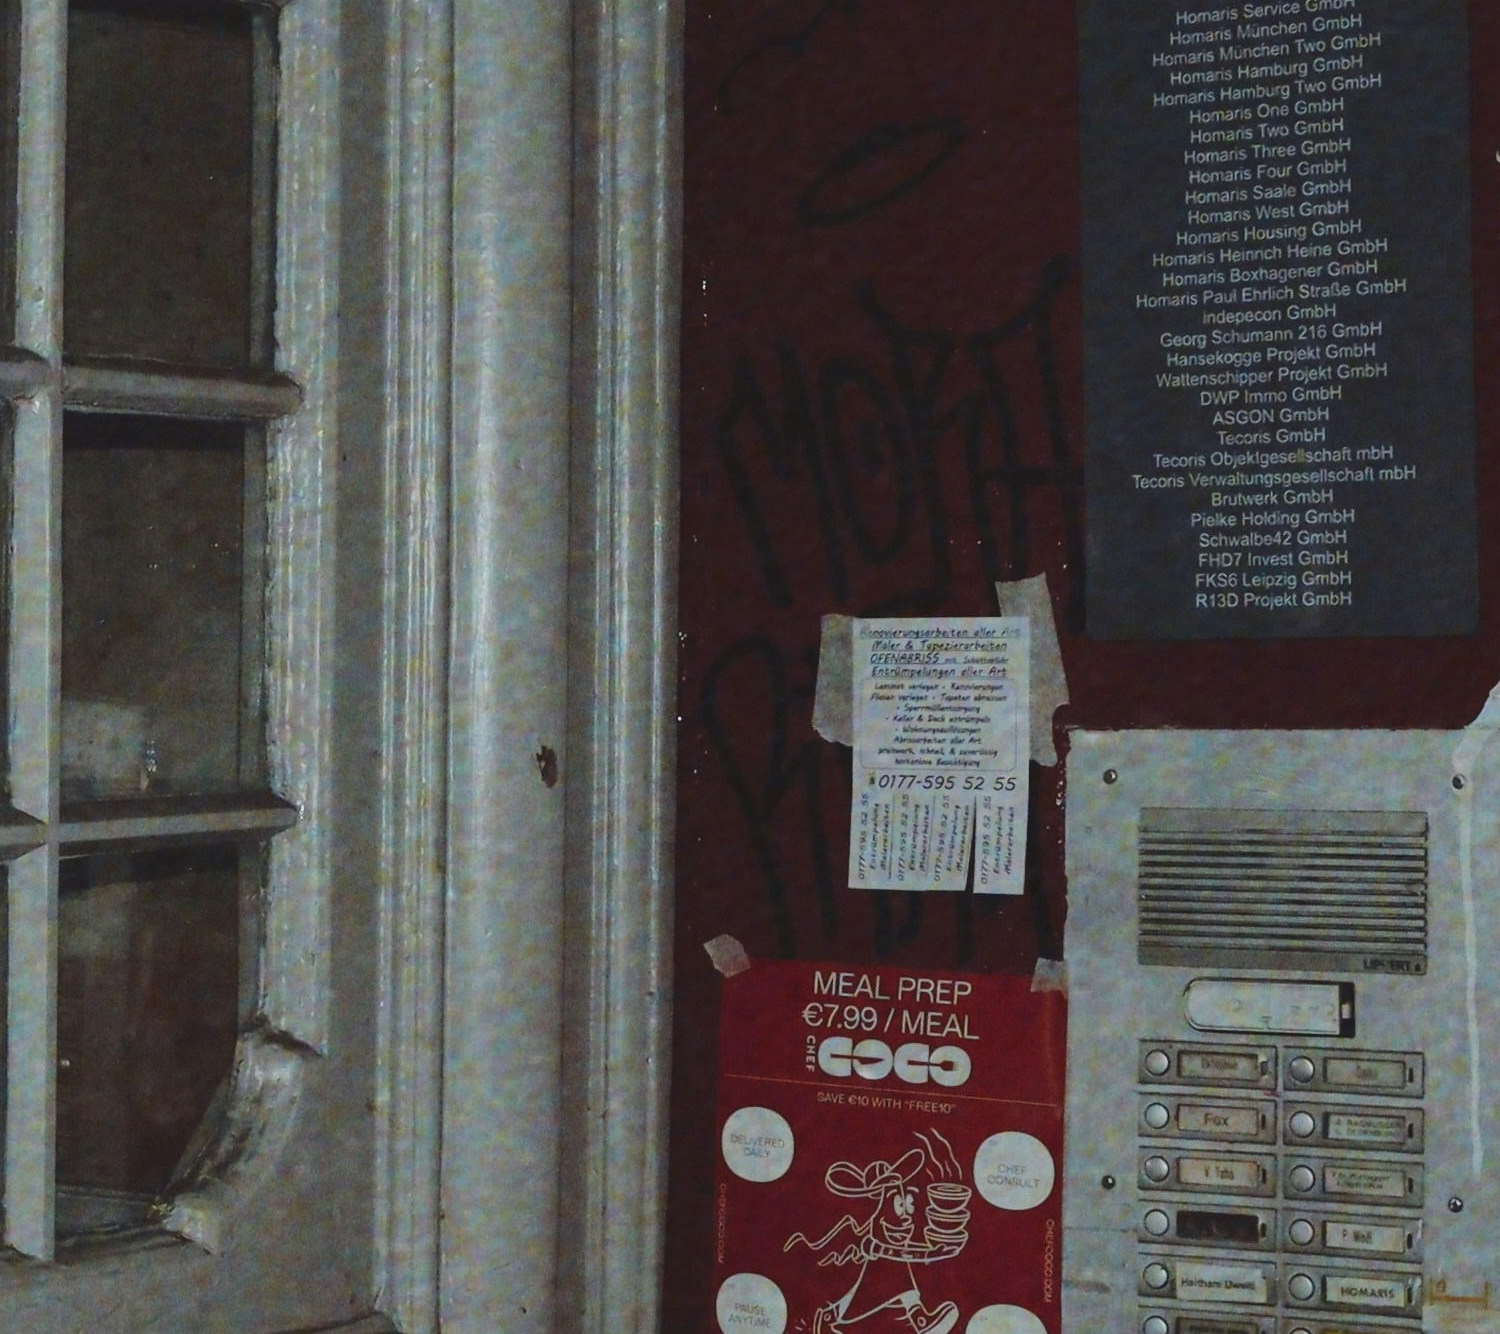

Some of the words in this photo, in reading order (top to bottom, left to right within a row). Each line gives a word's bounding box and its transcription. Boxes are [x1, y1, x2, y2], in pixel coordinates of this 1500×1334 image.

[1176, 6, 1238, 26] Homaris
[1243, 1, 1301, 19] Service
[1170, 27, 1232, 46] Homaris
[1237, 21, 1307, 39] München
[1312, 14, 1362, 32] GmbH
[1152, 48, 1215, 67] Homaris
[1219, 42, 1290, 61] München
[1294, 39, 1326, 54] Two
[1331, 32, 1382, 50] GmbH
[1170, 67, 1232, 86] Homaris
[1237, 62, 1308, 80] Hamburg
[1313, 54, 1363, 73] GmbH
[1153, 88, 1215, 107] Homaris
[1220, 84, 1290, 101] Hamburg
[1295, 80, 1326, 94] Two
[1332, 73, 1382, 91] GmbH
[1189, 106, 1252, 124] Homaris
[1257, 103, 1290, 118] One
[1294, 96, 1344, 115] GmbH
[1190, 126, 1253, 144] Homaris
[1258, 124, 1290, 138] Two
[1294, 117, 1344, 135] GmbH
[1184, 146, 1247, 164] Homaris
[1251, 144, 1296, 159] Three
[1301, 138, 1352, 155] GmbH
[1189, 166, 1252, 184] Homaris
[1257, 164, 1292, 179] Four
[1297, 159, 1347, 176] GmbH
[1185, 187, 1248, 205] Homaris
[1252, 183, 1297, 200] Saale
[1301, 179, 1352, 196] GmbH
[1188, 207, 1251, 225] Homaris
[1255, 203, 1294, 220] West
[1299, 199, 1350, 217] GmbH
[1176, 228, 1239, 246] Homaris
[1244, 224, 1307, 241] Housing
[1311, 219, 1362, 236] GmbH
[1153, 250, 1215, 267] Homaris
[1287, 243, 1332, 259] Heine
[1337, 238, 1388, 255] GmbH
[1163, 269, 1225, 287] Homaris
[1327, 260, 1378, 277] GmbH
[1136, 291, 1198, 309] Homaris
[1203, 288, 1238, 305] Paul
[1242, 285, 1294, 302] Ehrlich
[1298, 282, 1351, 299] Straße
[1356, 279, 1407, 296] GmbH
[1203, 308, 1282, 326] indepecon
[1287, 303, 1337, 320] GmbH
[1160, 333, 1206, 349] Georg
[1211, 329, 1294, 345] Schumann
[1298, 324, 1327, 340] 216
[1332, 322, 1383, 338] GmbH
[1267, 345, 1321, 364] Projekt
[1325, 342, 1376, 359] GmbH
[1278, 366, 1333, 385] Projekt
[1337, 364, 1388, 380] GmbH
[1200, 390, 1240, 406] DWP
[1244, 389, 1288, 404] Immo
[1292, 385, 1342, 402] GmbH
[1212, 409, 1274, 426] ASGON
[1279, 407, 1330, 423] GmbH
[1217, 429, 1271, 445] Tecoris
[1275, 427, 1326, 443] GmbH
[1153, 452, 1206, 468] Tecoris
[1356, 445, 1394, 461] mbH
[1132, 473, 1185, 489] Tecoris
[1379, 465, 1416, 481] mbH
[1211, 490, 1278, 506] Brutwerk
[1283, 489, 1333, 505] GmbH
[1191, 512, 1237, 527] Pielke
[1242, 510, 1300, 528] Holding
[1304, 508, 1355, 524] GmbH
[1200, 531, 1292, 547] Schwalbe42
[1296, 529, 1347, 545] GmbH
[1198, 552, 1242, 568] FHD7
[1247, 551, 1294, 567] Invest
[1298, 549, 1349, 565] GmbH
[1195, 572, 1238, 587] FKS6
[1242, 571, 1297, 590] Leipzig
[1302, 570, 1352, 586] GmbH
[1195, 593, 1239, 608] R13D
[1243, 592, 1298, 610] Projekt
[1302, 591, 1352, 606] GmbH
[872, 640, 902, 650] Maler
[920, 639, 1008, 652] Tapezierarbeiten
[870, 653, 941, 664] OFENABRISS
[872, 666, 956, 679] Entrümpelungen
[960, 665, 984, 676] aller
[988, 665, 1008, 676] Art
[879, 774, 956, 792] 0177-595
[962, 776, 985, 791] 52
[993, 776, 1017, 791] 55
[813, 970, 891, 1000] MEAL
[898, 976, 972, 1005] PREP
[802, 1002, 878, 1031] €7.99
[901, 1009, 981, 1040] MEAL
[805, 1035, 816, 1072] CHEF
[817, 1035, 972, 1087] COCO
[817, 1091, 845, 1104] SAVE
[848, 1094, 869, 1106] €10
[872, 1096, 901, 1110] WITH
[730, 1133, 786, 1148] DELIVERED
[743, 1146, 771, 1158] DAILY
[997, 1163, 1027, 1175] CHEF
[987, 1174, 1041, 1189] CONSULT
[1341, 1286, 1395, 1299] HOMARIS
[734, 1302, 766, 1316] PAUSE
[728, 1314, 772, 1328] ANYTIME
